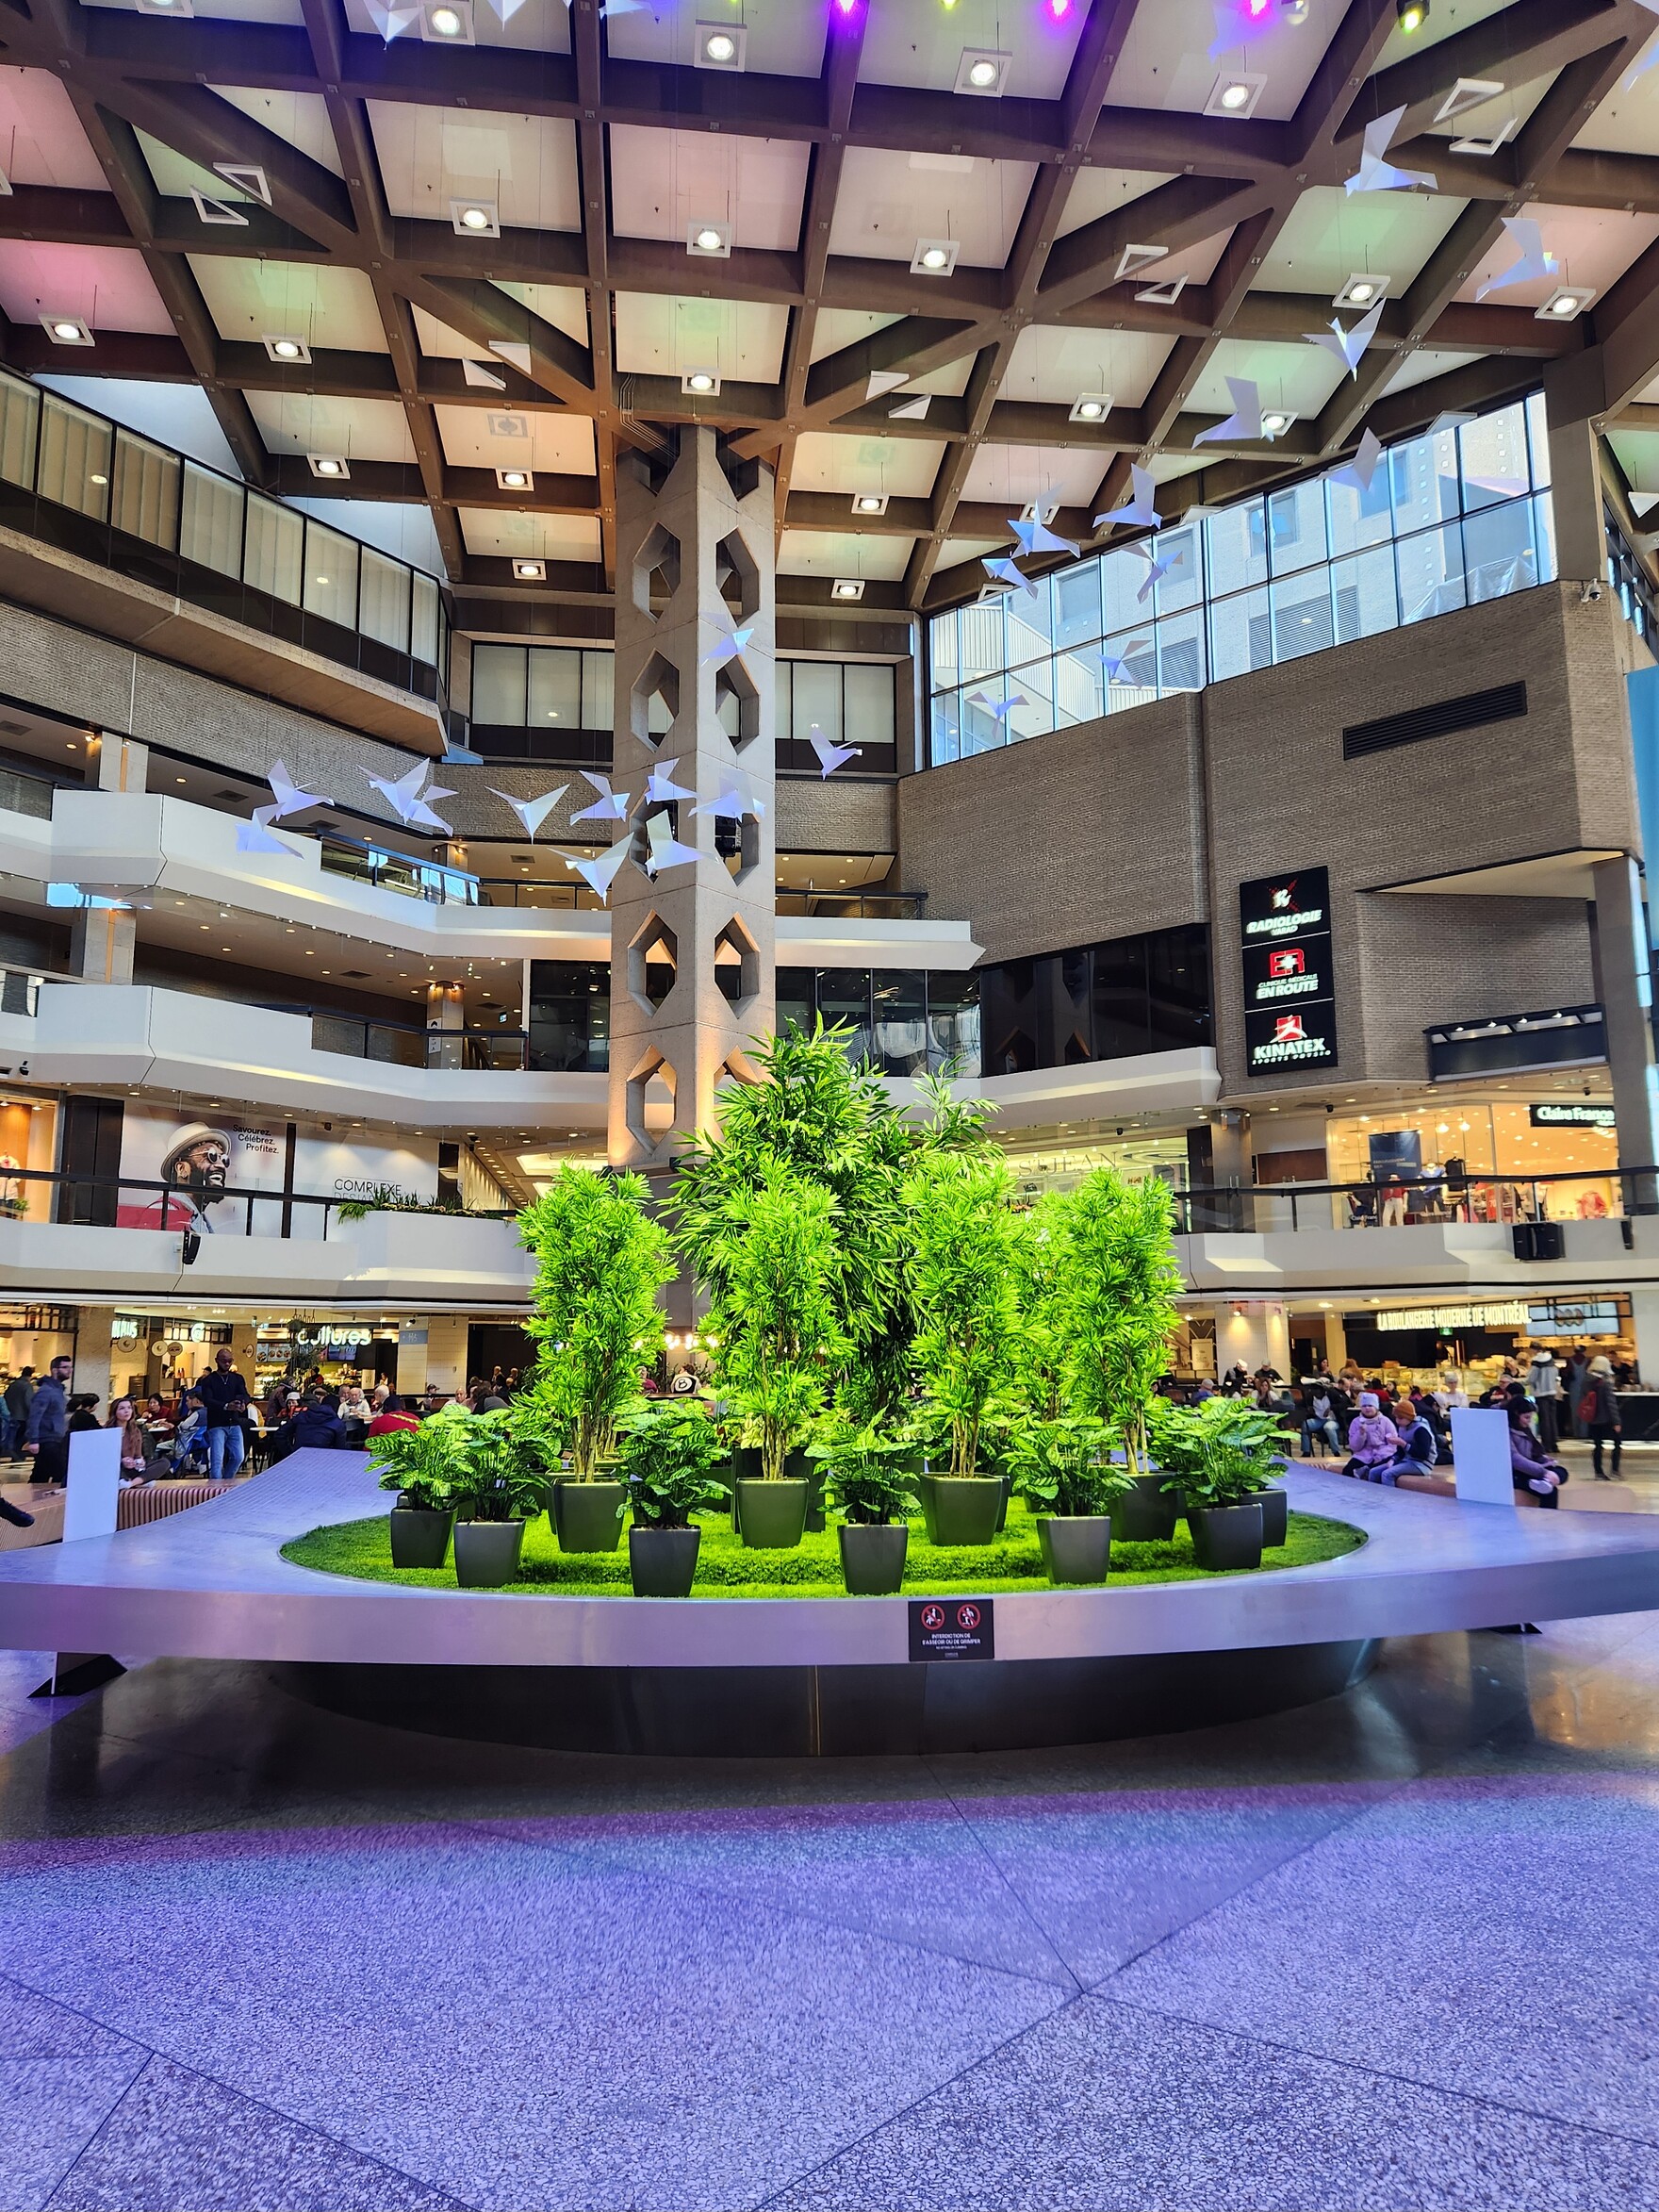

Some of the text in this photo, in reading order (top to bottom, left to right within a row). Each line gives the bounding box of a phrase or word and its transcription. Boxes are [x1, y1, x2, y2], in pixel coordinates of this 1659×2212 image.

[1246, 910, 1322, 933] RADIOLOGIE
[1257, 980, 1319, 999] EN ROUTE
[1254, 1038, 1326, 1059] KINATEX
[1536, 1106, 1616, 1121] Claire France
[233, 1125, 271, 1136] Savourez.
[238, 1133, 275, 1145] Célébrez.
[246, 1143, 280, 1154] Profitez.
[334, 1179, 402, 1197] COMPLEXE
[1377, 1312, 1388, 1331] LA
[1388, 1311, 1436, 1330] BOULANGERIE
[1435, 1308, 1472, 1329] MODERNE
[1472, 1306, 1485, 1327] DE
[297, 1326, 372, 1345] cultures
